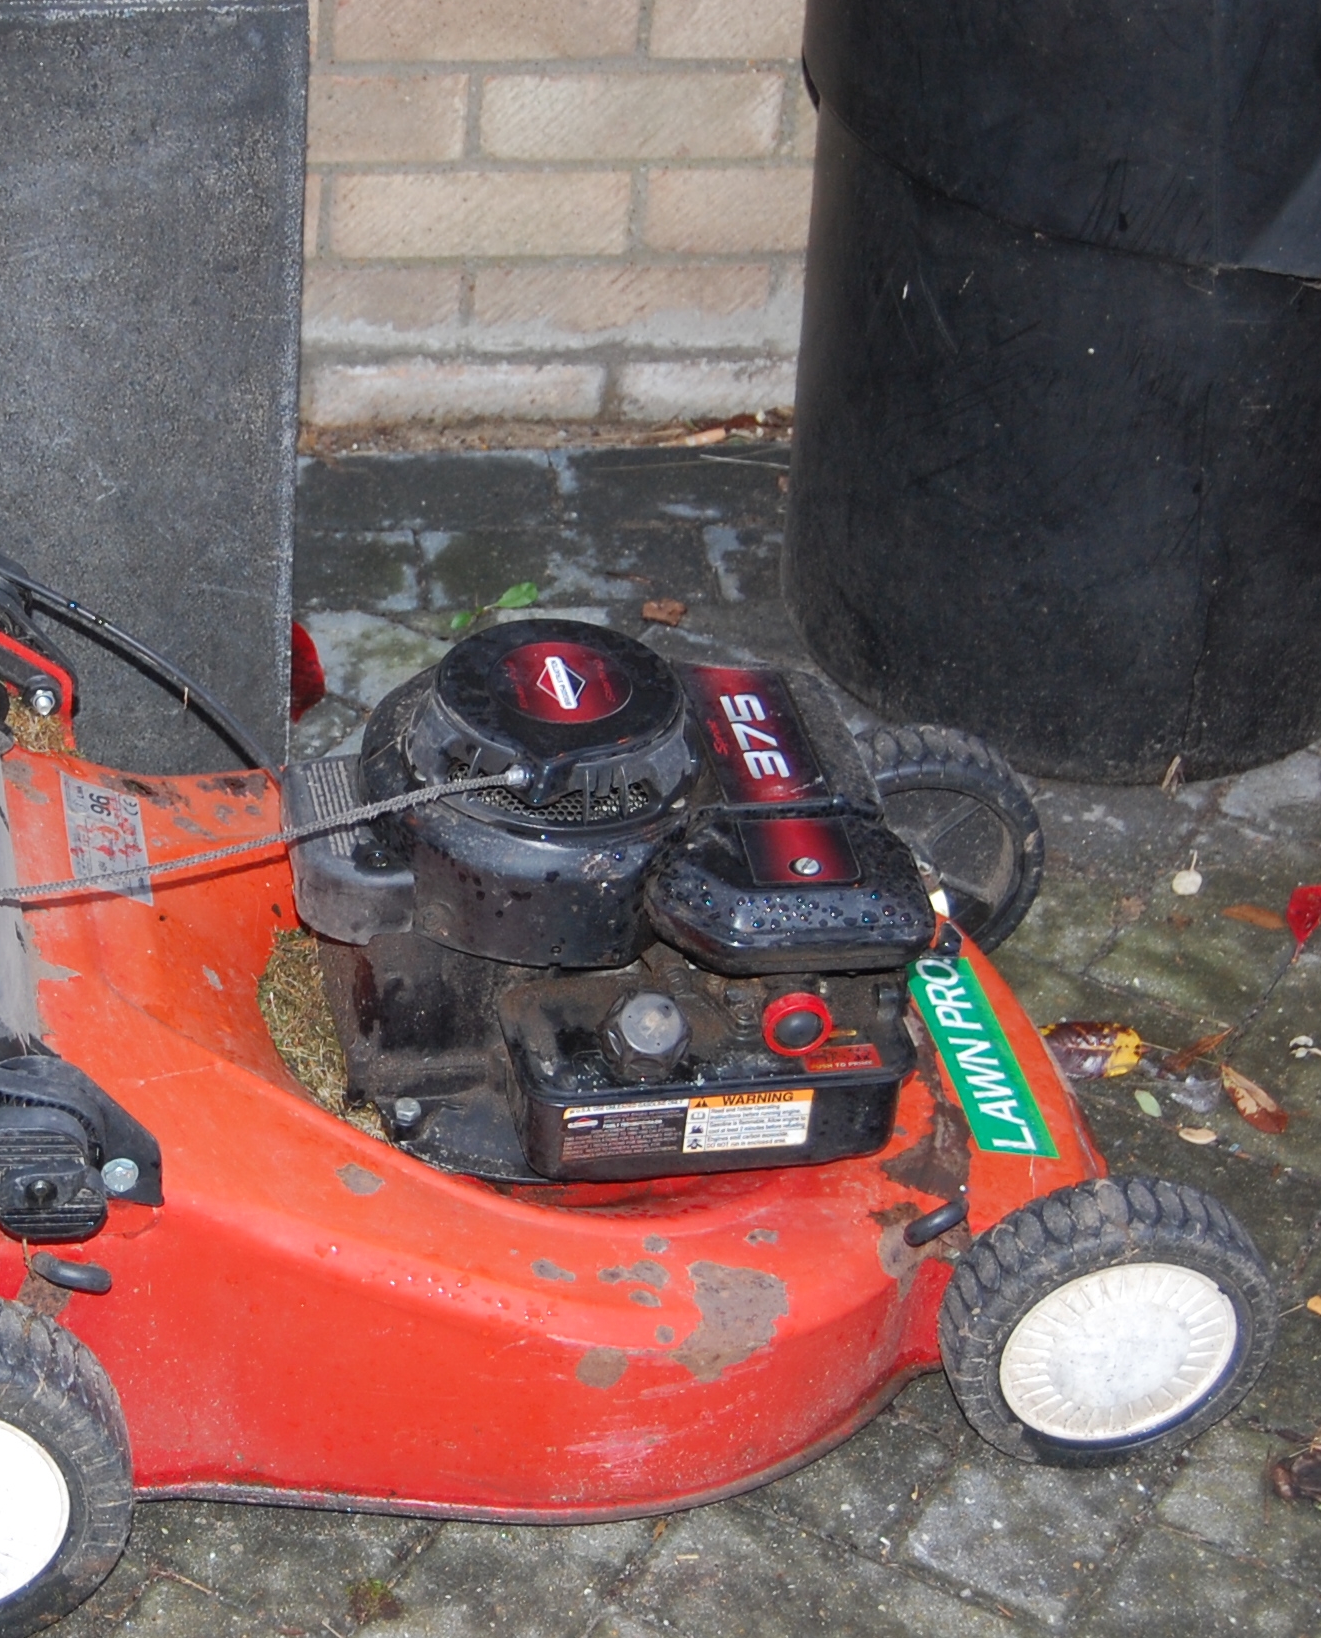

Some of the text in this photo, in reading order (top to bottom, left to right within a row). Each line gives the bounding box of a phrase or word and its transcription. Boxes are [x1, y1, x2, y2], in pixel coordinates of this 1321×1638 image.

[719, 694, 790, 779] 375
[89, 792, 112, 817] 96
[722, 1091, 794, 1106] WARNING
[947, 1036, 1037, 1151] LAWN
